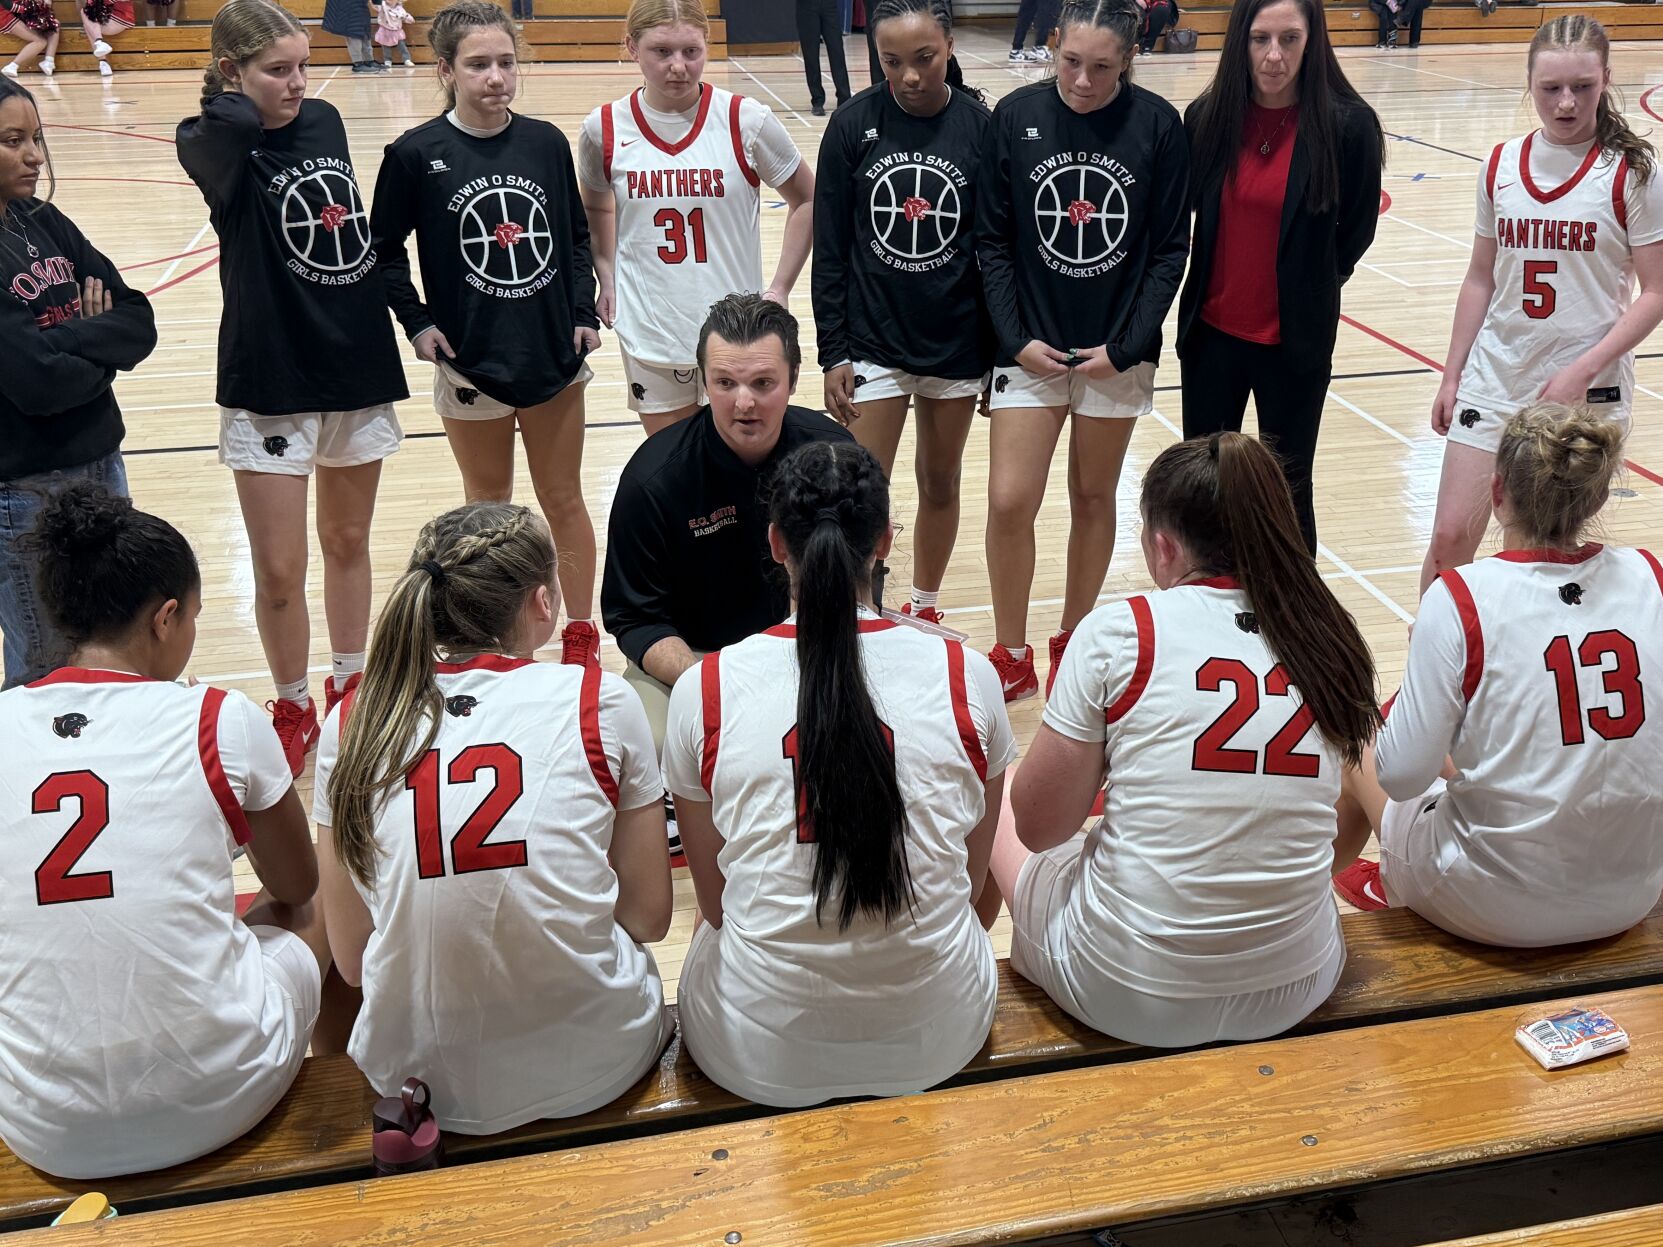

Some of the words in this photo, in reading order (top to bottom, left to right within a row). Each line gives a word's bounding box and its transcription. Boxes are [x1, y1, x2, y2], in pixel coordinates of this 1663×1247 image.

[303, 160, 314, 171] O
[865, 152, 909, 180] EDWIN
[913, 152, 922, 162] O
[925, 155, 968, 188] SMITH
[1029, 152, 1073, 183] EDWIN
[1077, 152, 1087, 162] O
[1090, 153, 1136, 187] SMITH
[447, 177, 489, 213] EDWIN
[492, 175, 502, 185] O
[627, 168, 725, 199] PANTHERS
[653, 207, 708, 264] 31
[1498, 217, 1598, 252] PANTHERS
[287, 258, 320, 282] GIRLS
[870, 240, 894, 265] GIRLS
[893, 247, 958, 272] BASKETBALL
[1059, 250, 1128, 278] BASKETBALL
[465, 273, 495, 295] GIRLS
[496, 268, 558, 299] BASKETBALL
[1522, 260, 1557, 319] 5
[1543, 628, 1646, 747] 13
[1191, 656, 1320, 778] 22
[405, 742, 528, 880] 12
[31, 769, 114, 906] 2
